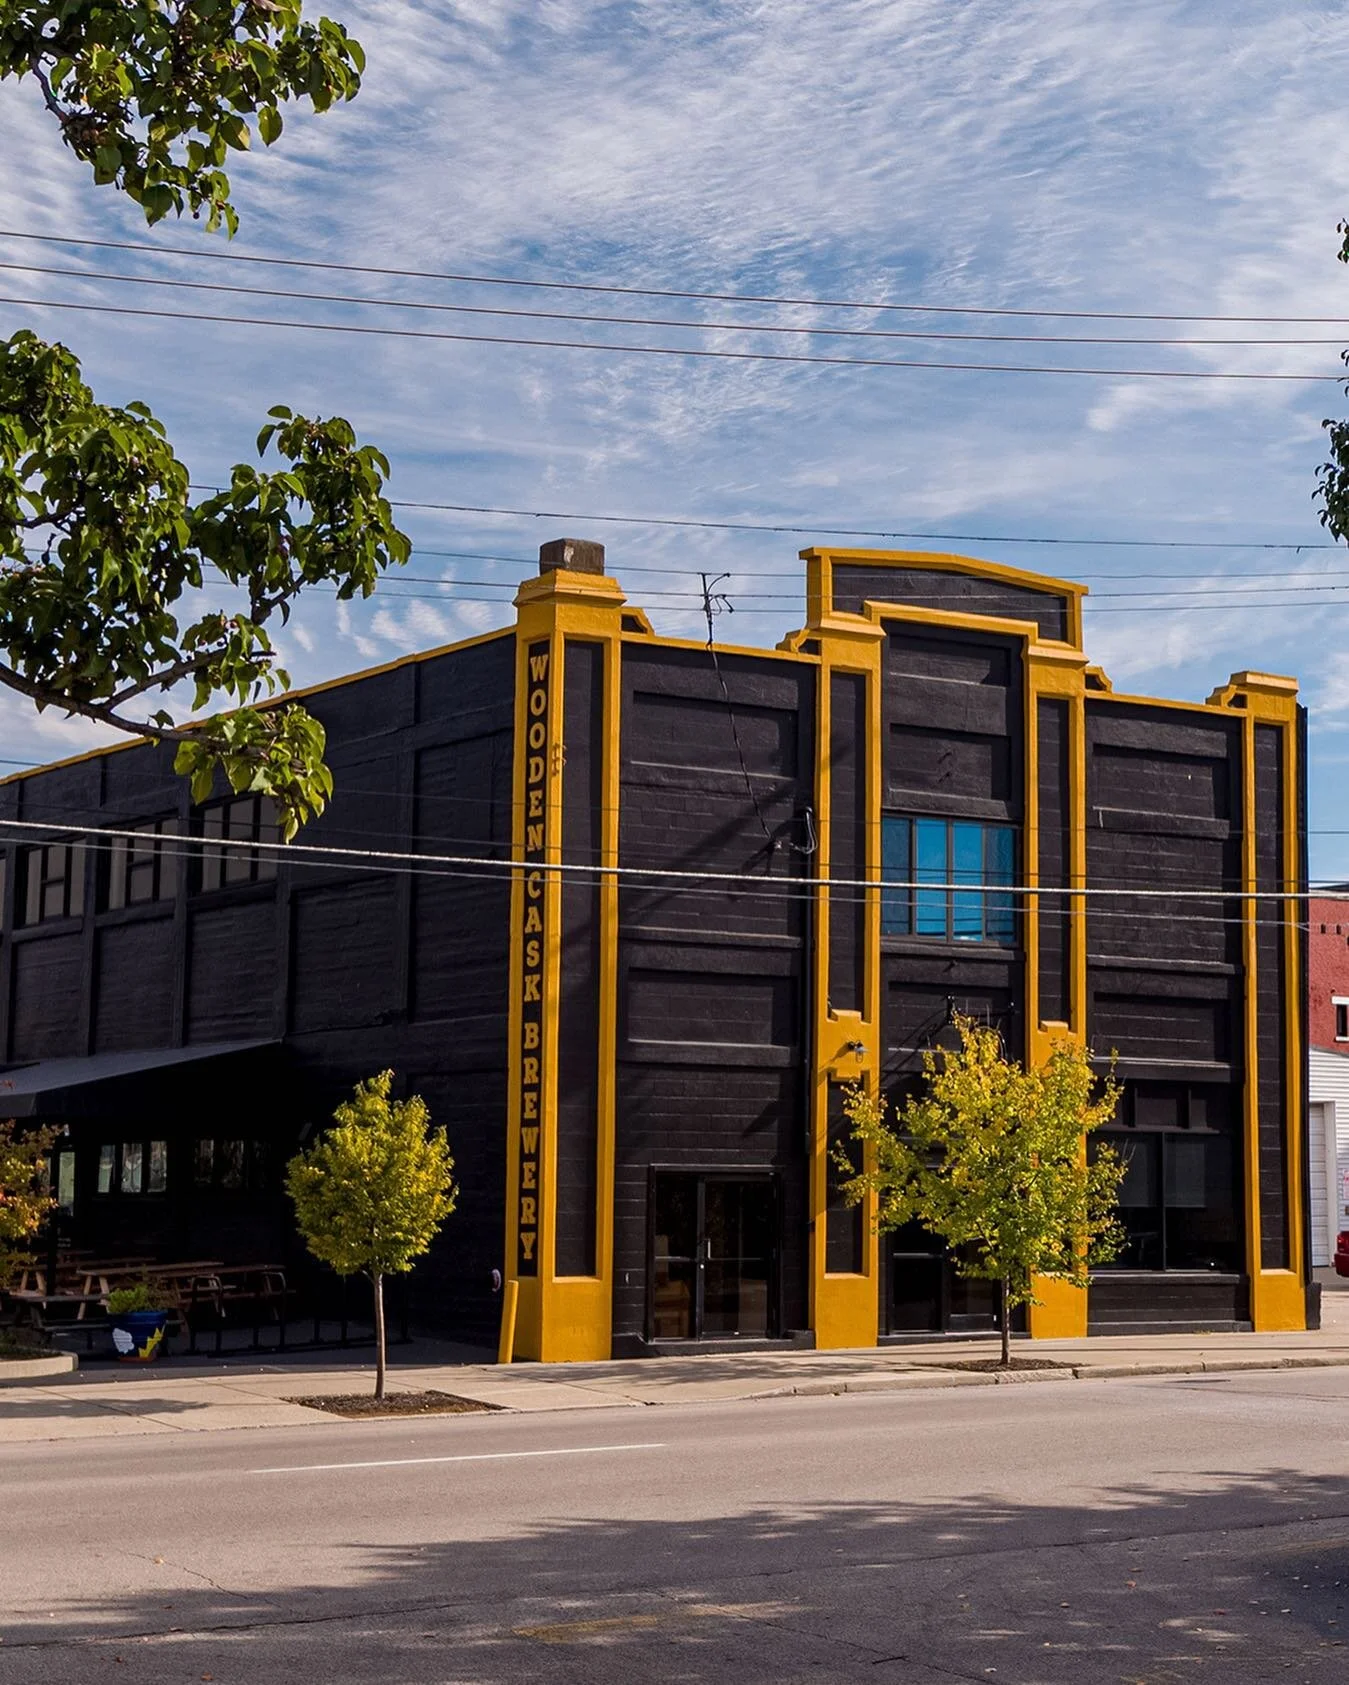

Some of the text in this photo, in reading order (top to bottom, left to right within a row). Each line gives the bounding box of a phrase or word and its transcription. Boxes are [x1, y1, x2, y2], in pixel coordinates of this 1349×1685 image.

[520, 654, 548, 1259] WOODEN CASK BREWERY
